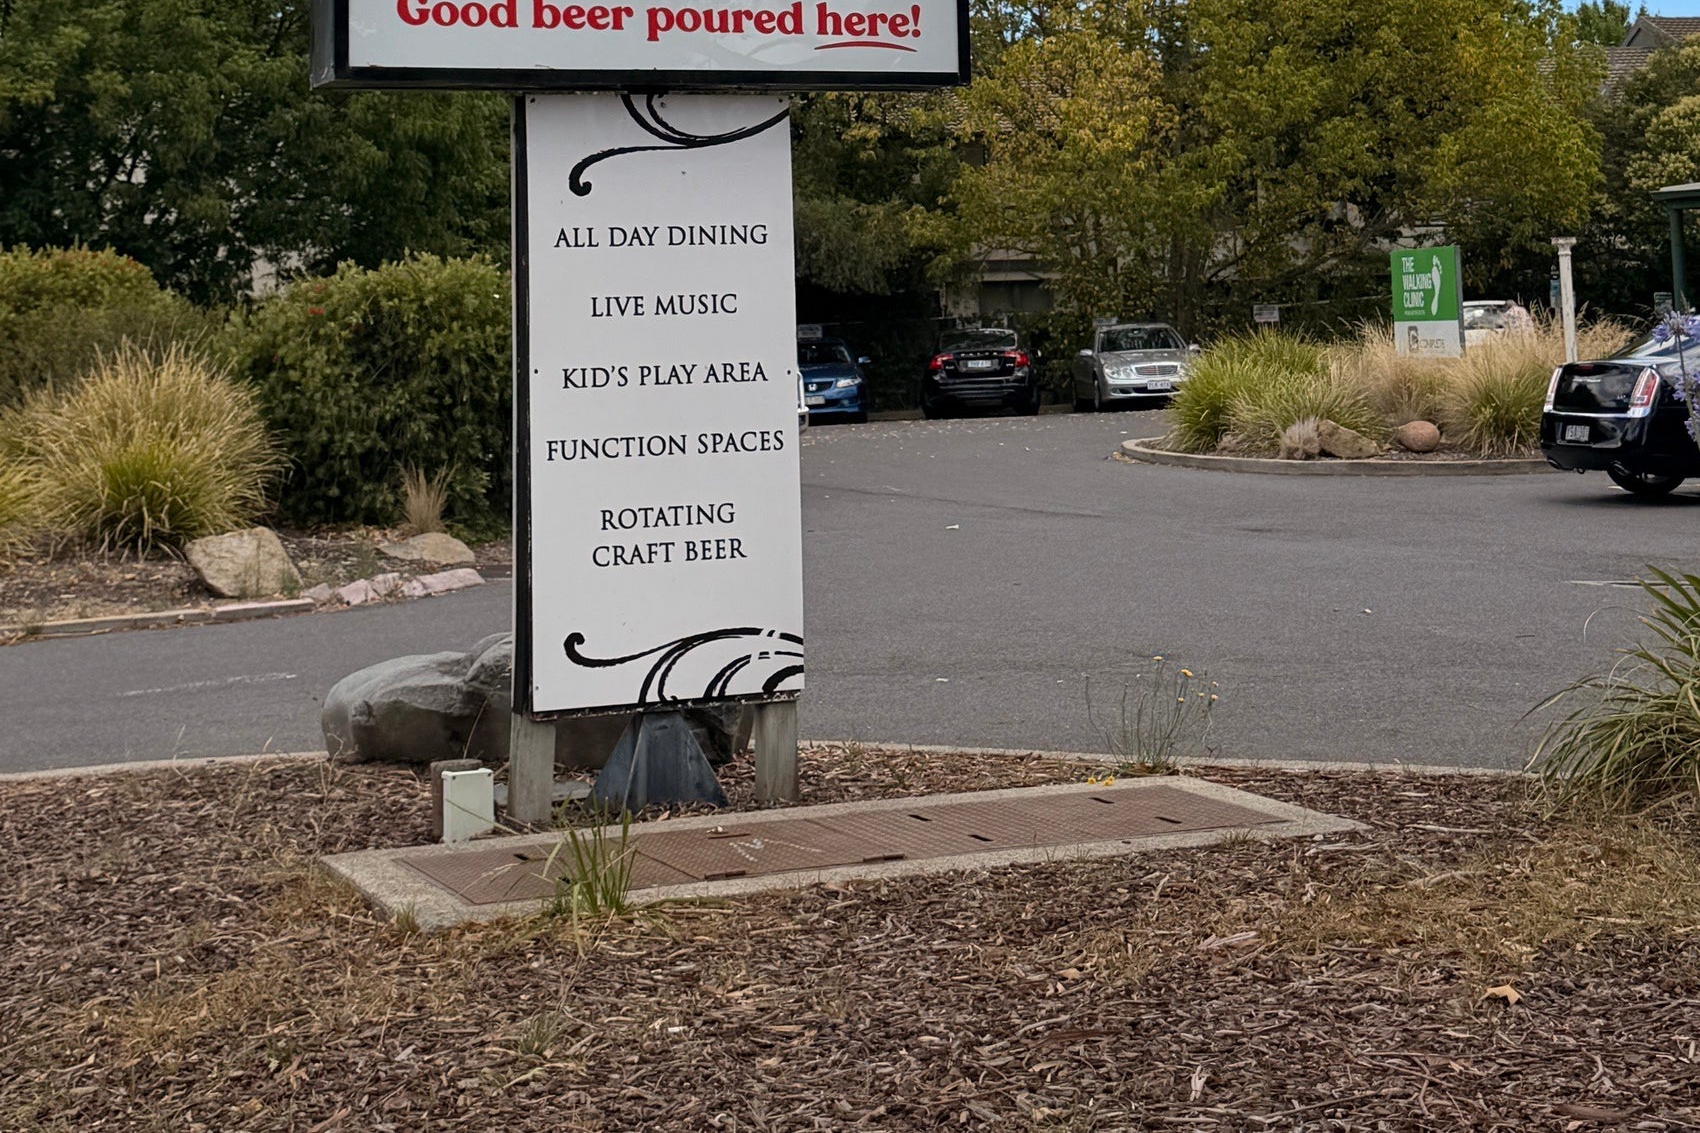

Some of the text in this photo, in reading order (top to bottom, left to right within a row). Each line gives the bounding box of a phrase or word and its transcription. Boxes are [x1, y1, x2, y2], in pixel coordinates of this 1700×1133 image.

[647, 2, 803, 42] poured
[817, 3, 920, 37] here!
[553, 224, 768, 248] ALL DAY DINING
[1401, 257, 1415, 273] THE
[1402, 273, 1432, 289] WALKING
[591, 293, 738, 318] LIVE MUSIC
[1404, 292, 1425, 307] CLINIC
[562, 361, 769, 389] KID'S PLAY AREA
[546, 430, 784, 462] FUNCTION SPACES
[600, 502, 735, 531] ROTATING
[592, 538, 748, 568] CRAFT BEER
